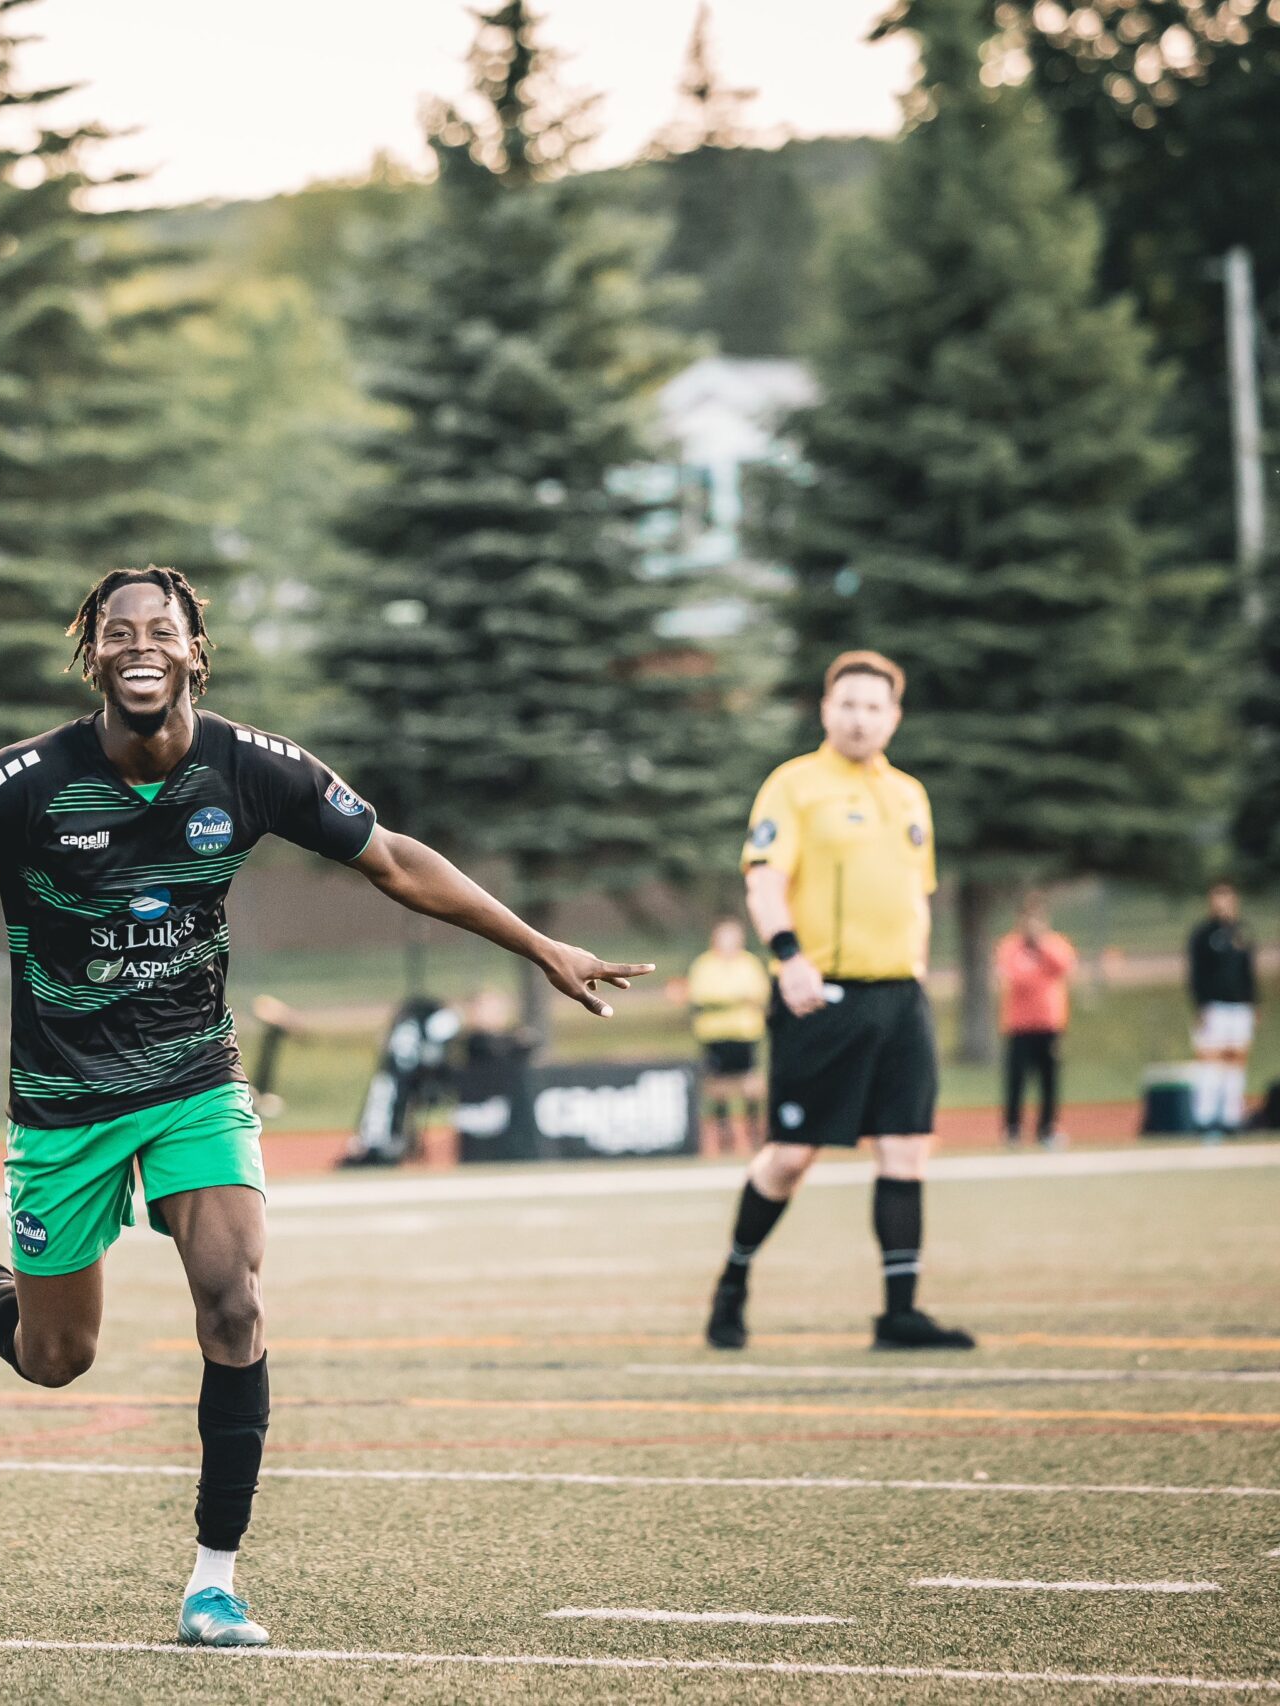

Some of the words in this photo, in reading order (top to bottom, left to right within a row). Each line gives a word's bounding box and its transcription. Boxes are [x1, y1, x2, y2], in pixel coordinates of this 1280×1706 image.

[60, 831, 110, 849] capelli
[188, 822, 231, 838] Duluth
[91, 927, 122, 951] St.
[15, 1219, 47, 1241] Duluth
